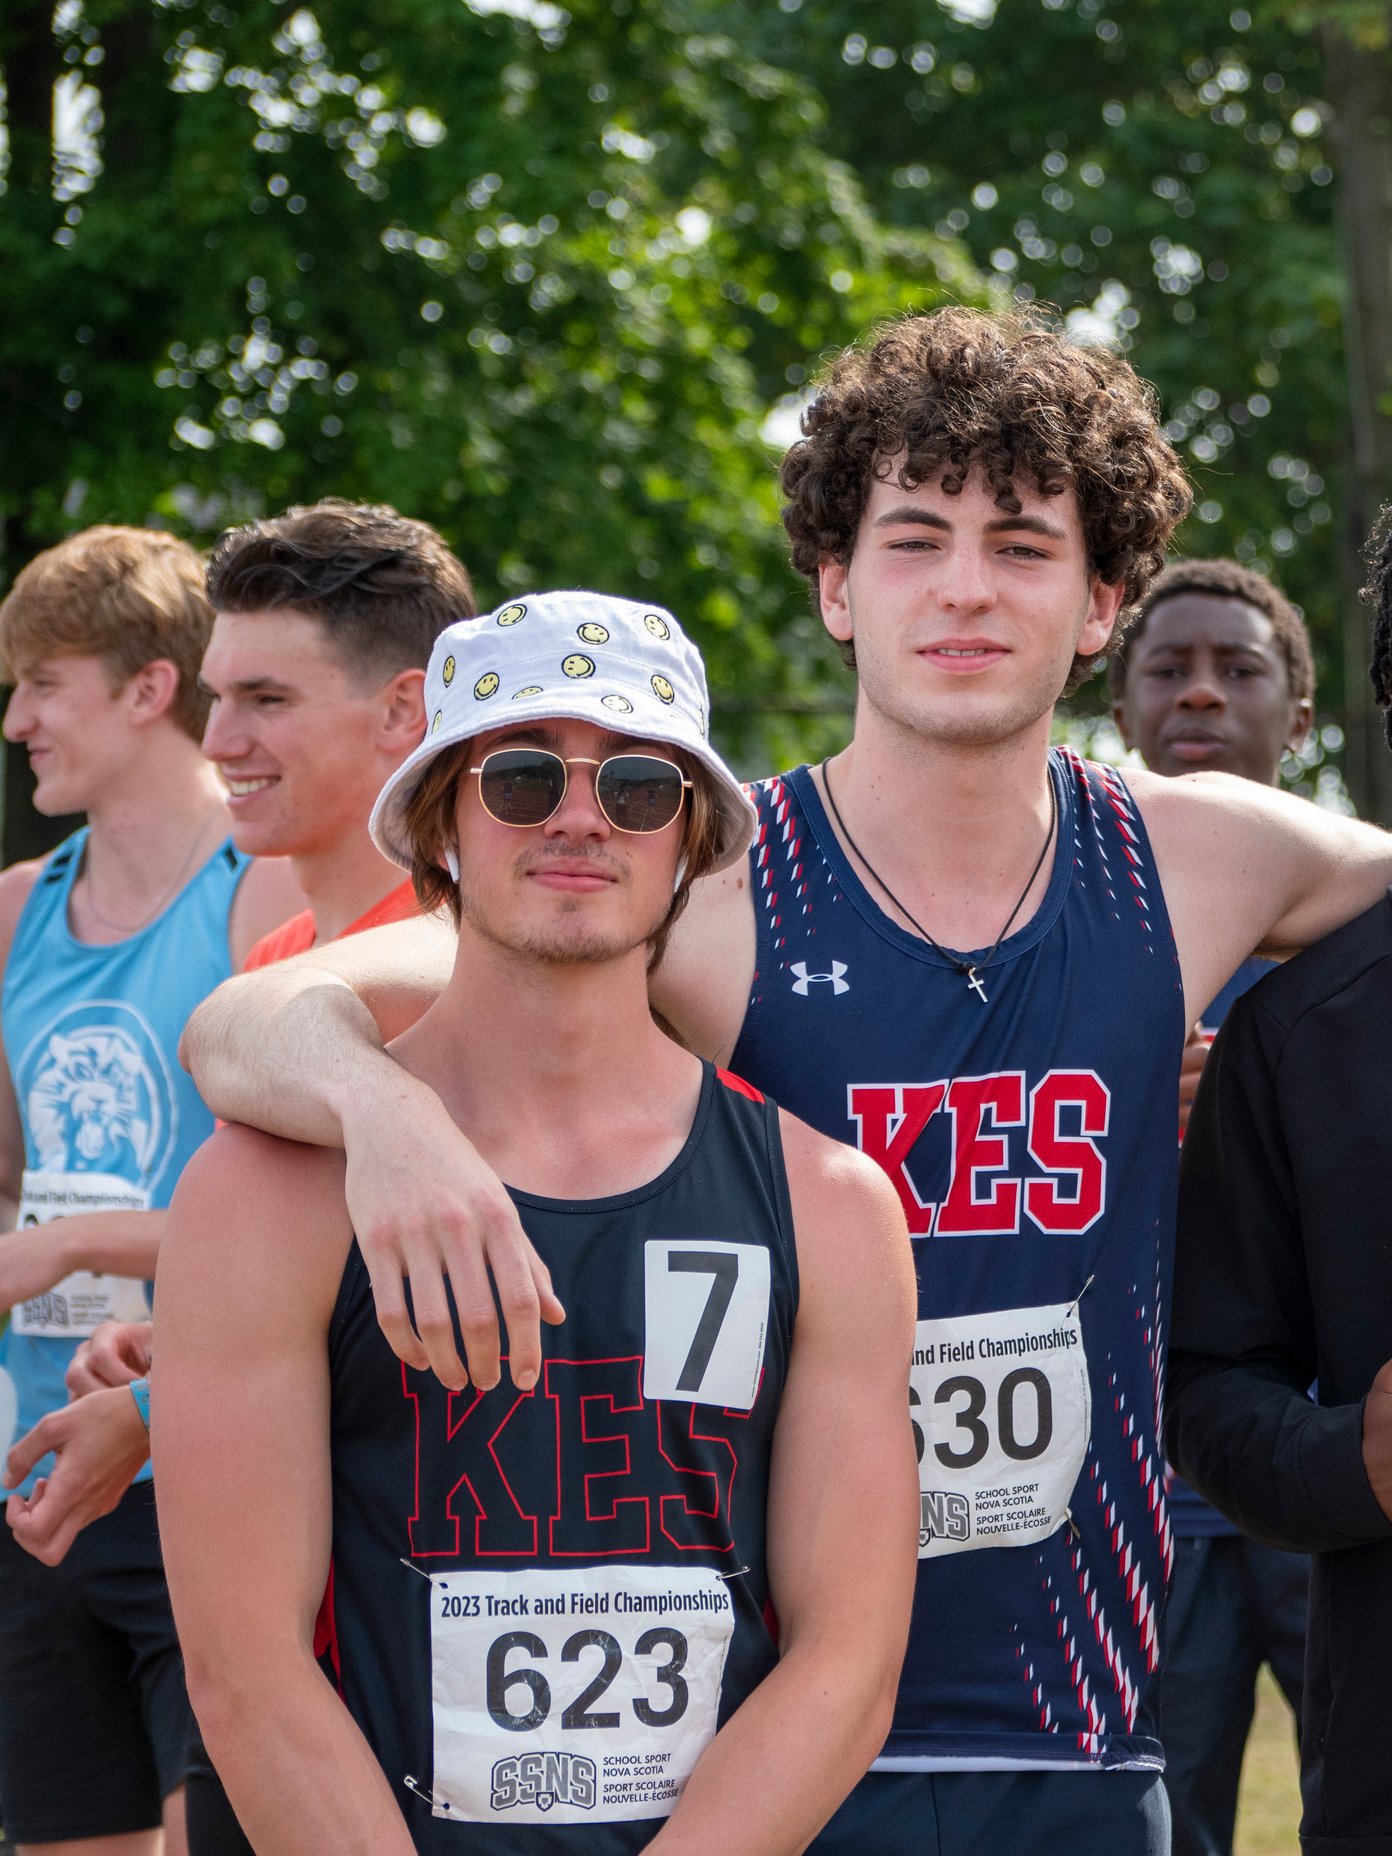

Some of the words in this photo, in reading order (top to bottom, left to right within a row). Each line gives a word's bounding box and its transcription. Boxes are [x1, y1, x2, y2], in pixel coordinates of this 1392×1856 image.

[847, 1069, 1111, 1238] KES
[668, 1250, 739, 1393] 7
[939, 1339, 975, 1364] Field
[978, 1327, 1078, 1358] Championships
[909, 1366, 1053, 1470] 30
[401, 1354, 765, 1557] KES
[975, 1488, 1010, 1500] SCHOOL
[1012, 1483, 1040, 1495] SPORT
[975, 1500, 1001, 1511] NOVA
[1002, 1495, 1034, 1507] SCOTIA
[976, 1513, 1004, 1525] SPORT
[1006, 1507, 1046, 1521] SCOLAIRE
[976, 1516, 1052, 1536] NOUVELLE-ÉCOSSE
[441, 1595, 481, 1617] 2023
[485, 1594, 530, 1616] Track
[534, 1593, 566, 1615] and
[570, 1592, 609, 1614] Field
[614, 1589, 730, 1615] Championships
[486, 1626, 689, 1732] 623
[603, 1755, 642, 1766] SCHOOL
[644, 1753, 672, 1764] SPORT
[603, 1767, 632, 1778] NOVA
[633, 1765, 664, 1776] SCOTIA
[490, 1751, 597, 1812] SSNS
[603, 1782, 633, 1793] SPORT
[635, 1779, 675, 1791] SCOLAIRE
[603, 1788, 679, 1804] NOUVELLE-ÉCOSSE
